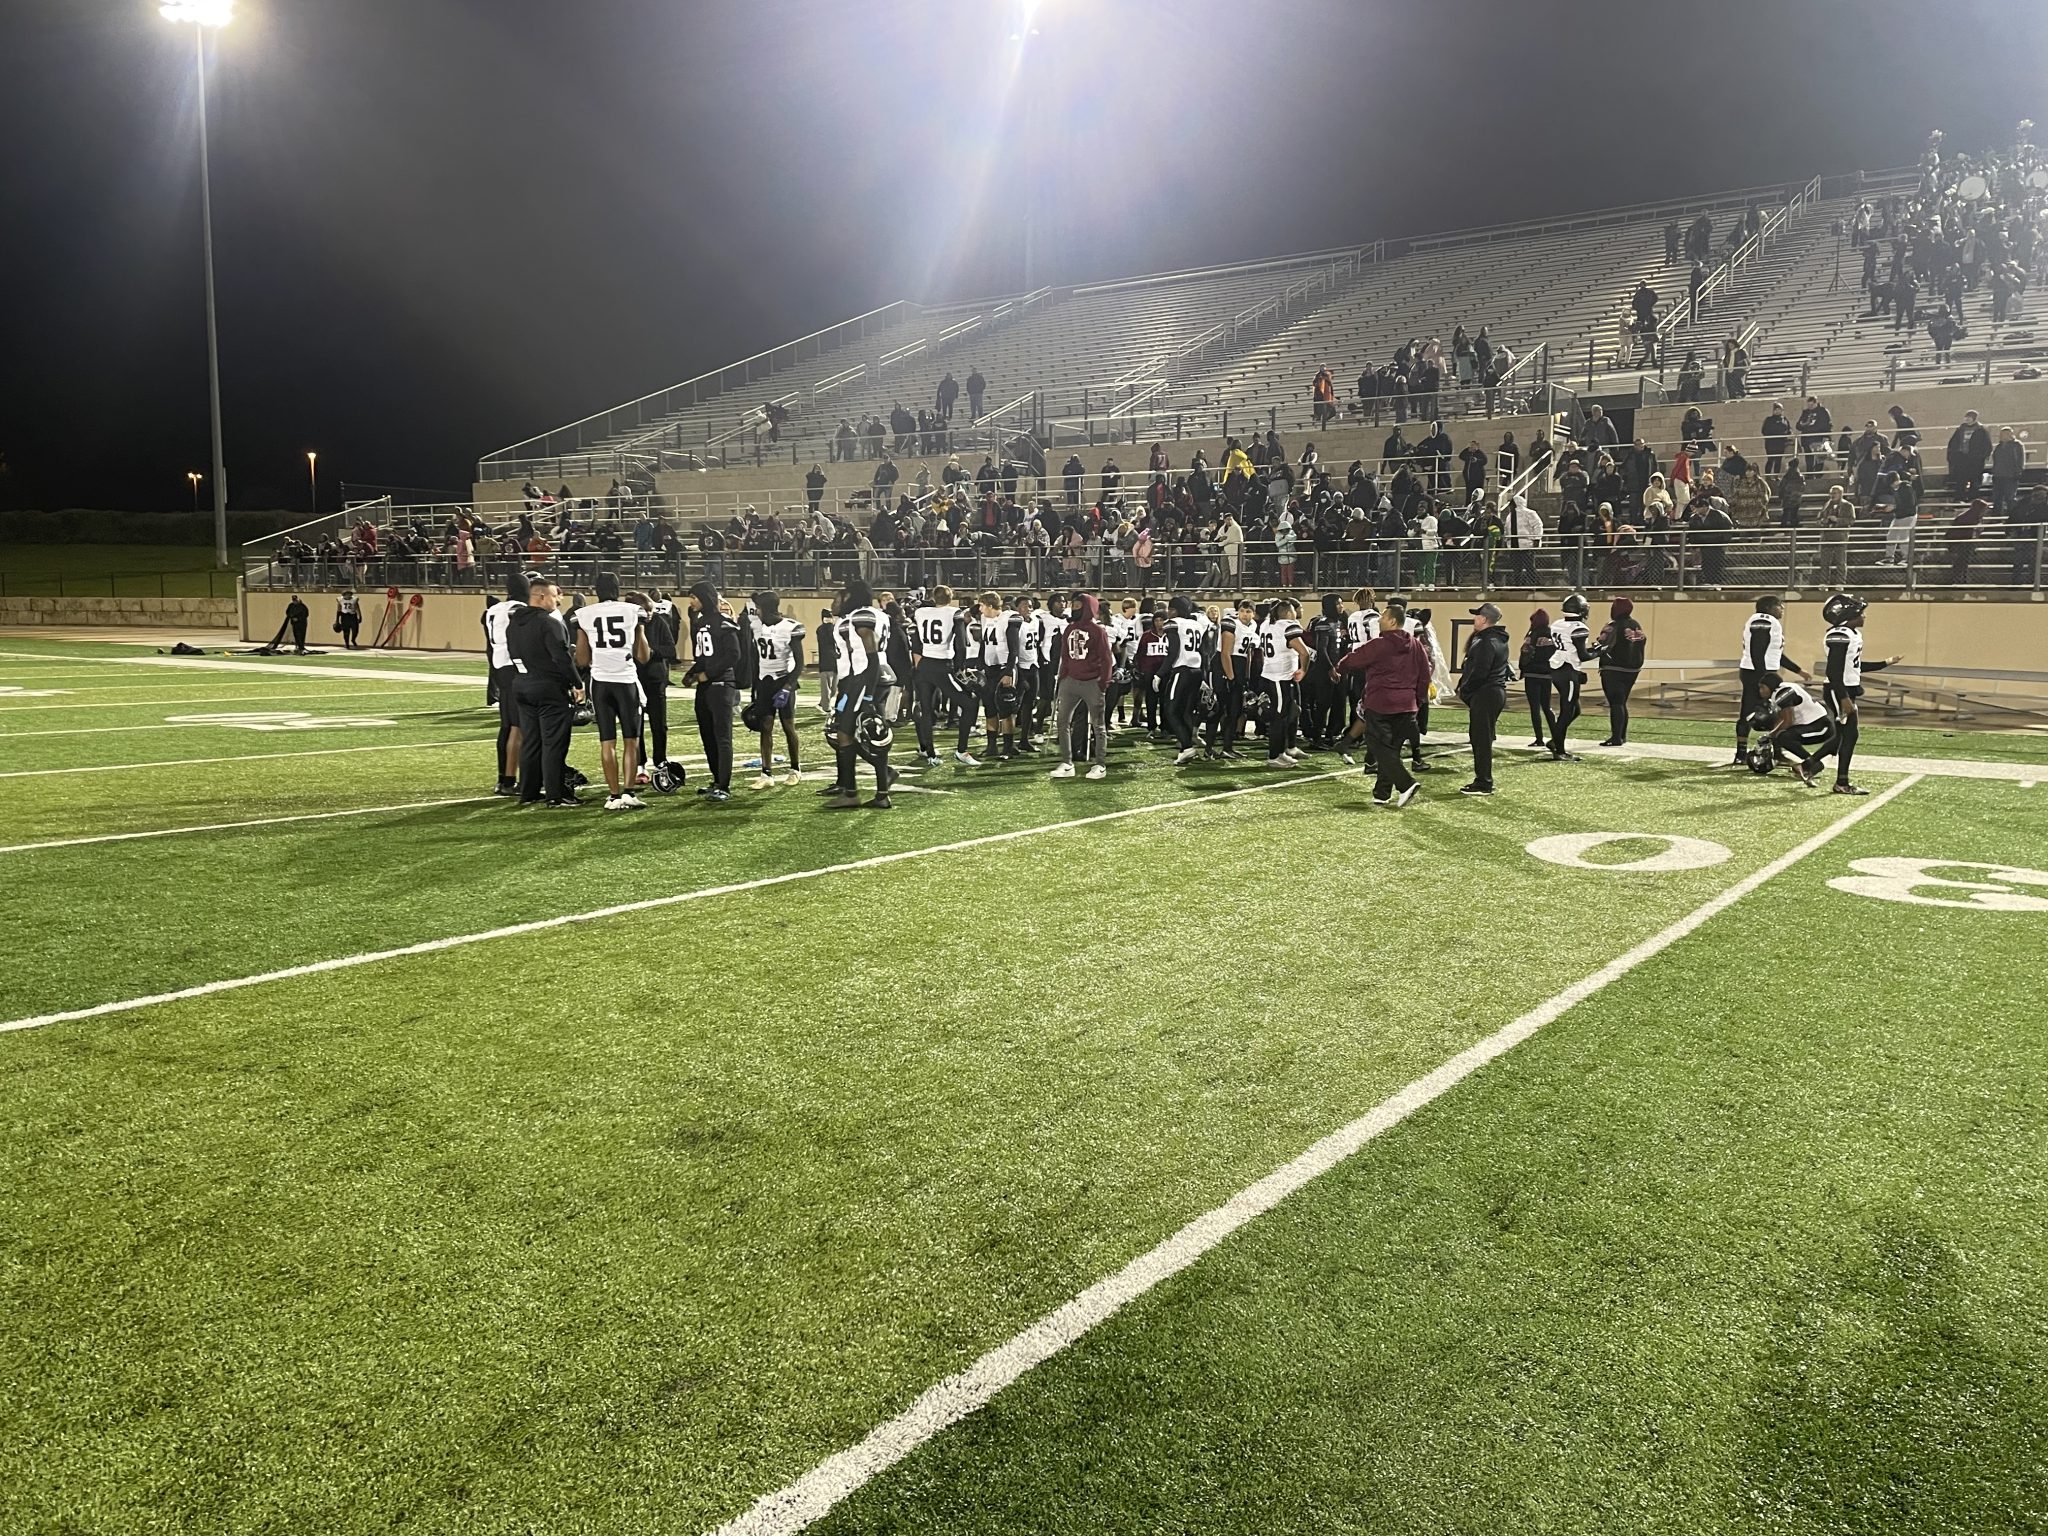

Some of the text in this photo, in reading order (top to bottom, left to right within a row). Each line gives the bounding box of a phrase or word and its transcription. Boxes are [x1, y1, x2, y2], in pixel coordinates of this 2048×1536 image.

[593, 615, 626, 648] 15
[922, 619, 943, 645] 16
[1238, 636, 1252, 654] 9
